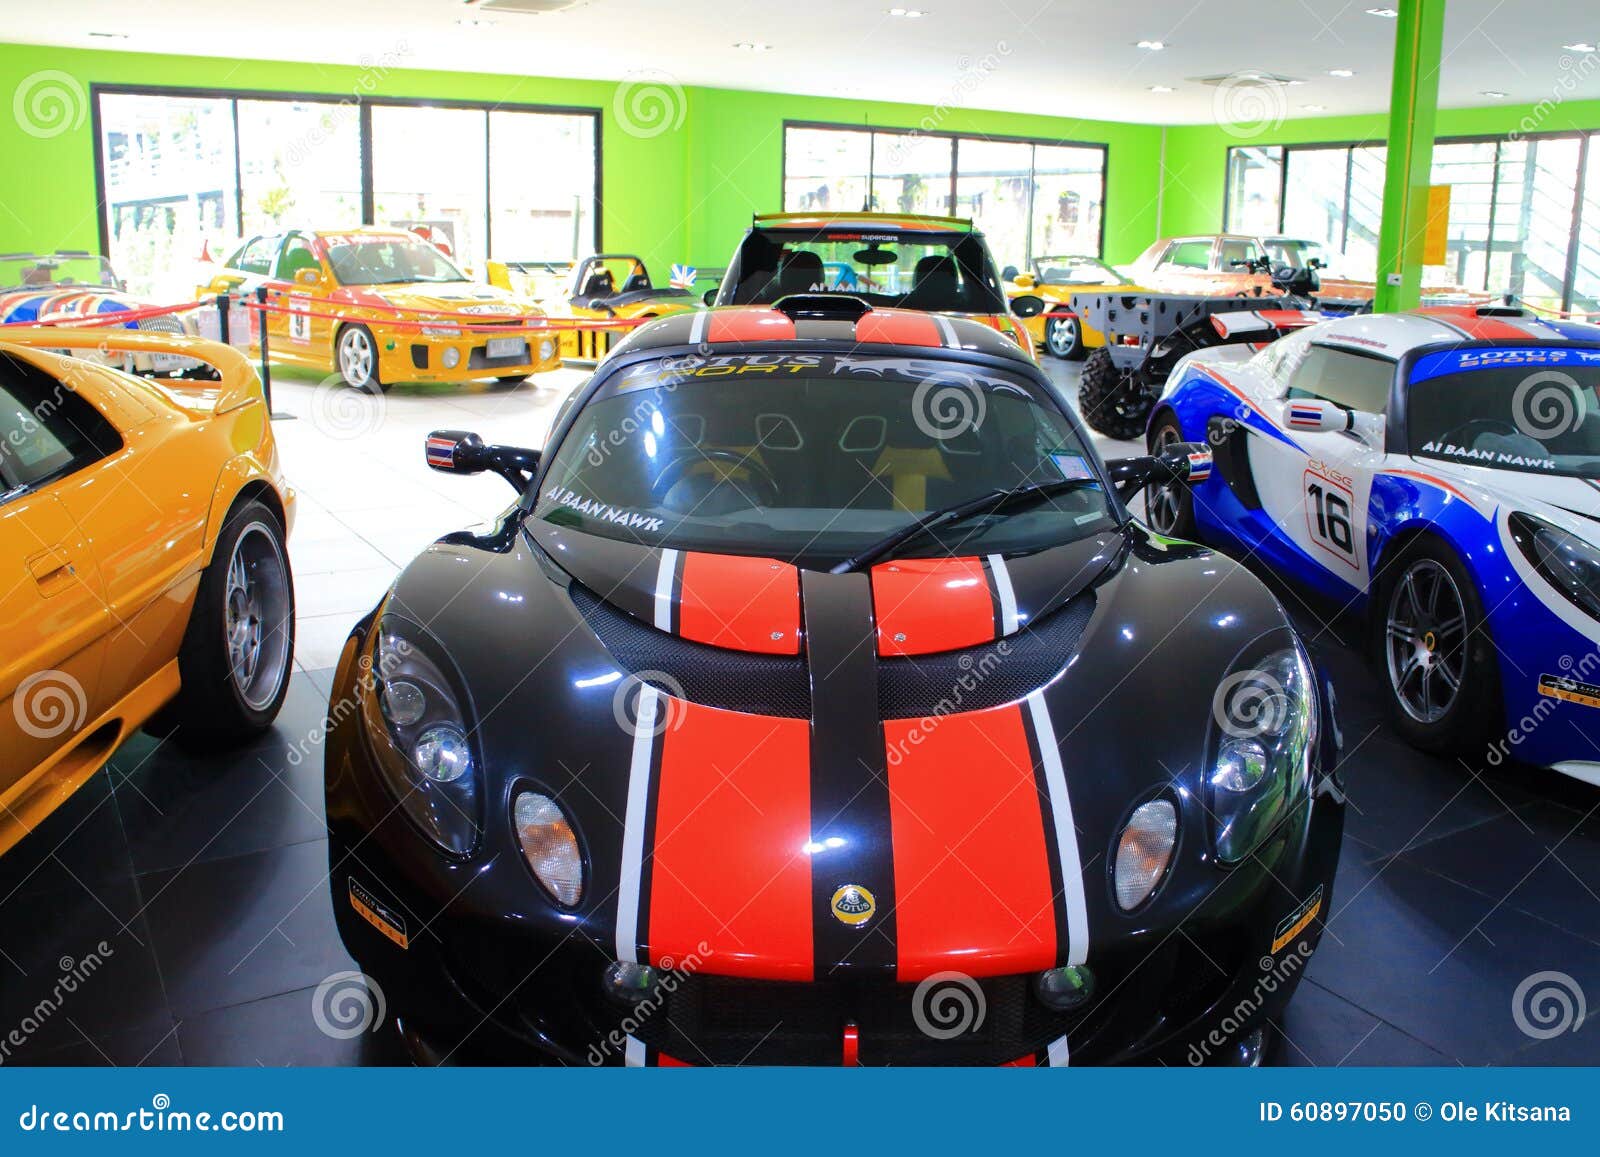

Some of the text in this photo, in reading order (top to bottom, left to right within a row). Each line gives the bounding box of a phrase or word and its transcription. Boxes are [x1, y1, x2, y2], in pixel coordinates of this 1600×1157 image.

[1459, 350, 1568, 362] LOTUS
[1460, 356, 1565, 368] SPORT
[1422, 441, 1556, 470] AI BAAN NAWK
[545, 485, 664, 532] AI BAAN NAWK
[1308, 483, 1353, 555] 16
[837, 901, 870, 912] LOTUS
